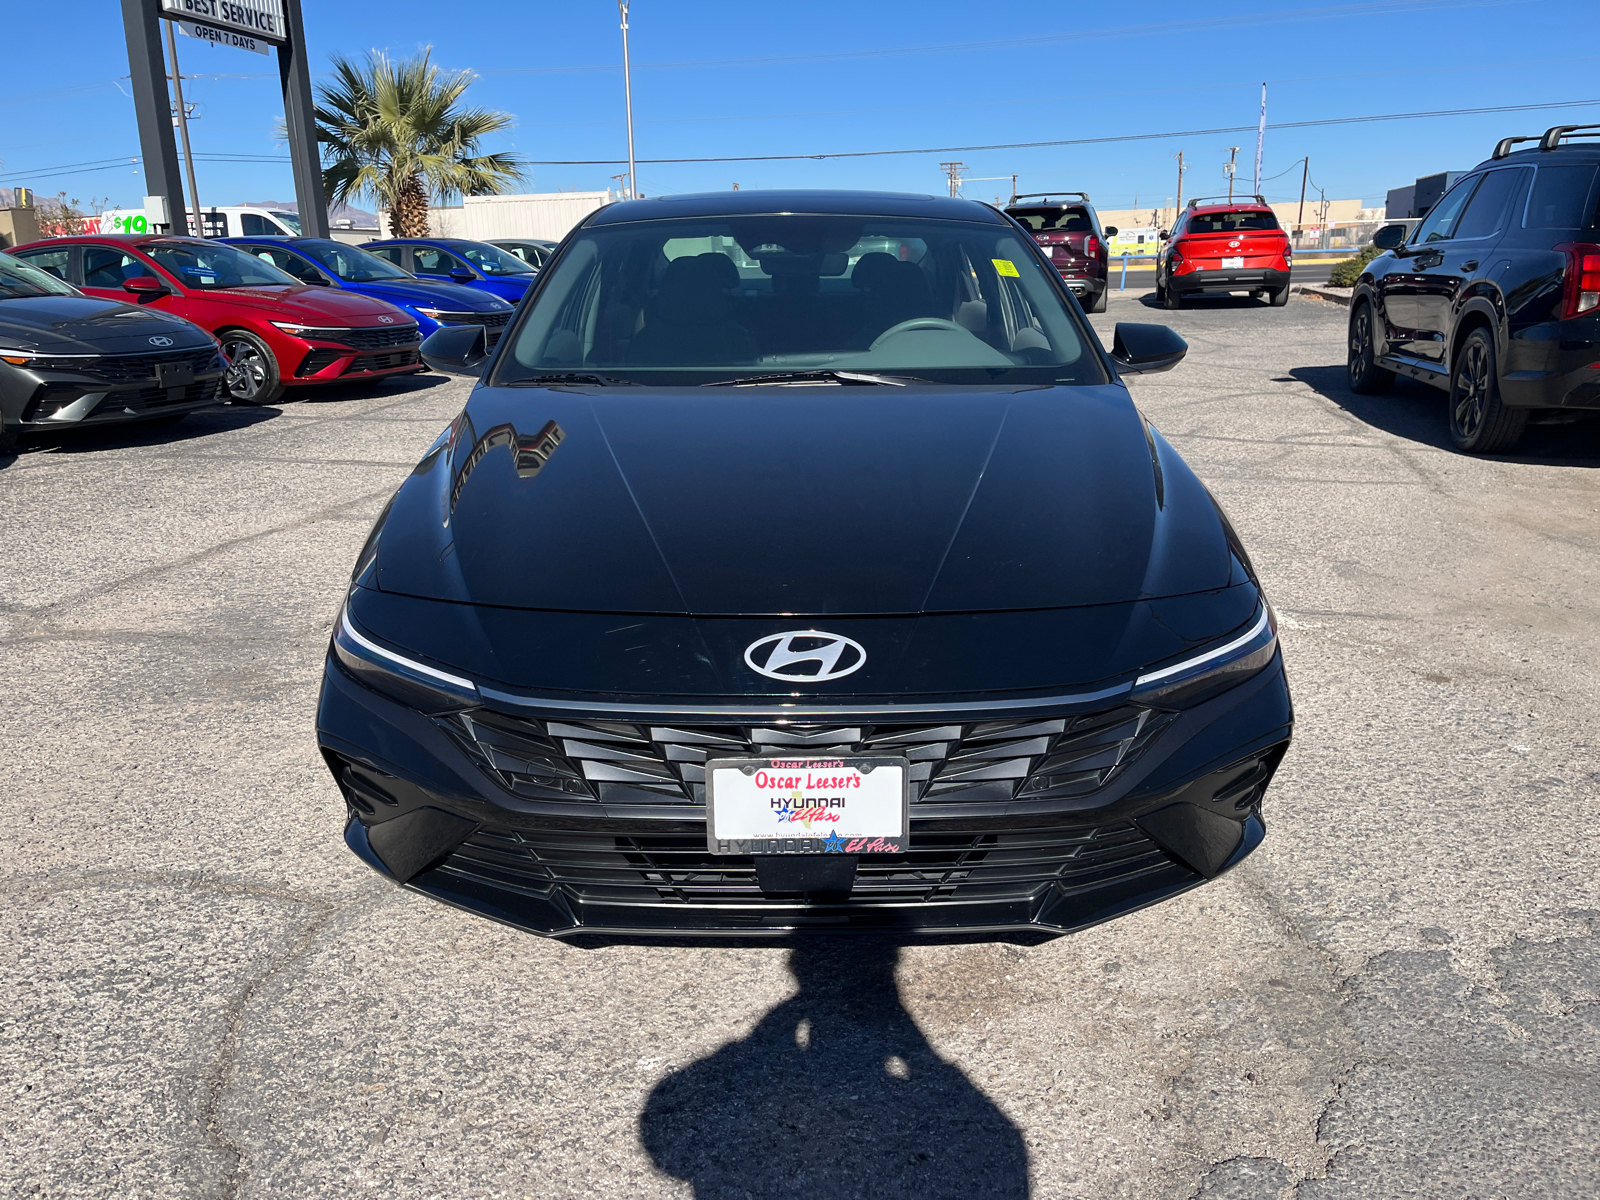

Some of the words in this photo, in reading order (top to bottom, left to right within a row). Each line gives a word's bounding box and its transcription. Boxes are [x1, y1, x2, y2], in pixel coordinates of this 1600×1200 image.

[186, 0, 216, 17] BEST
[221, 1, 275, 32] SERVICE
[195, 26, 222, 42] OPEN
[224, 33, 230, 44] 7
[232, 35, 256, 50] DAYS
[771, 759, 804, 768] Oscar
[806, 759, 844, 768] Leeser's
[755, 771, 802, 789] Oscar
[805, 773, 861, 790] Leeser's
[770, 797, 846, 808] HYUNDAI
[808, 806, 841, 823] Paso
[717, 839, 821, 854] HYUNDAI
[845, 837, 868, 852] El
[867, 837, 900, 853] Paso
